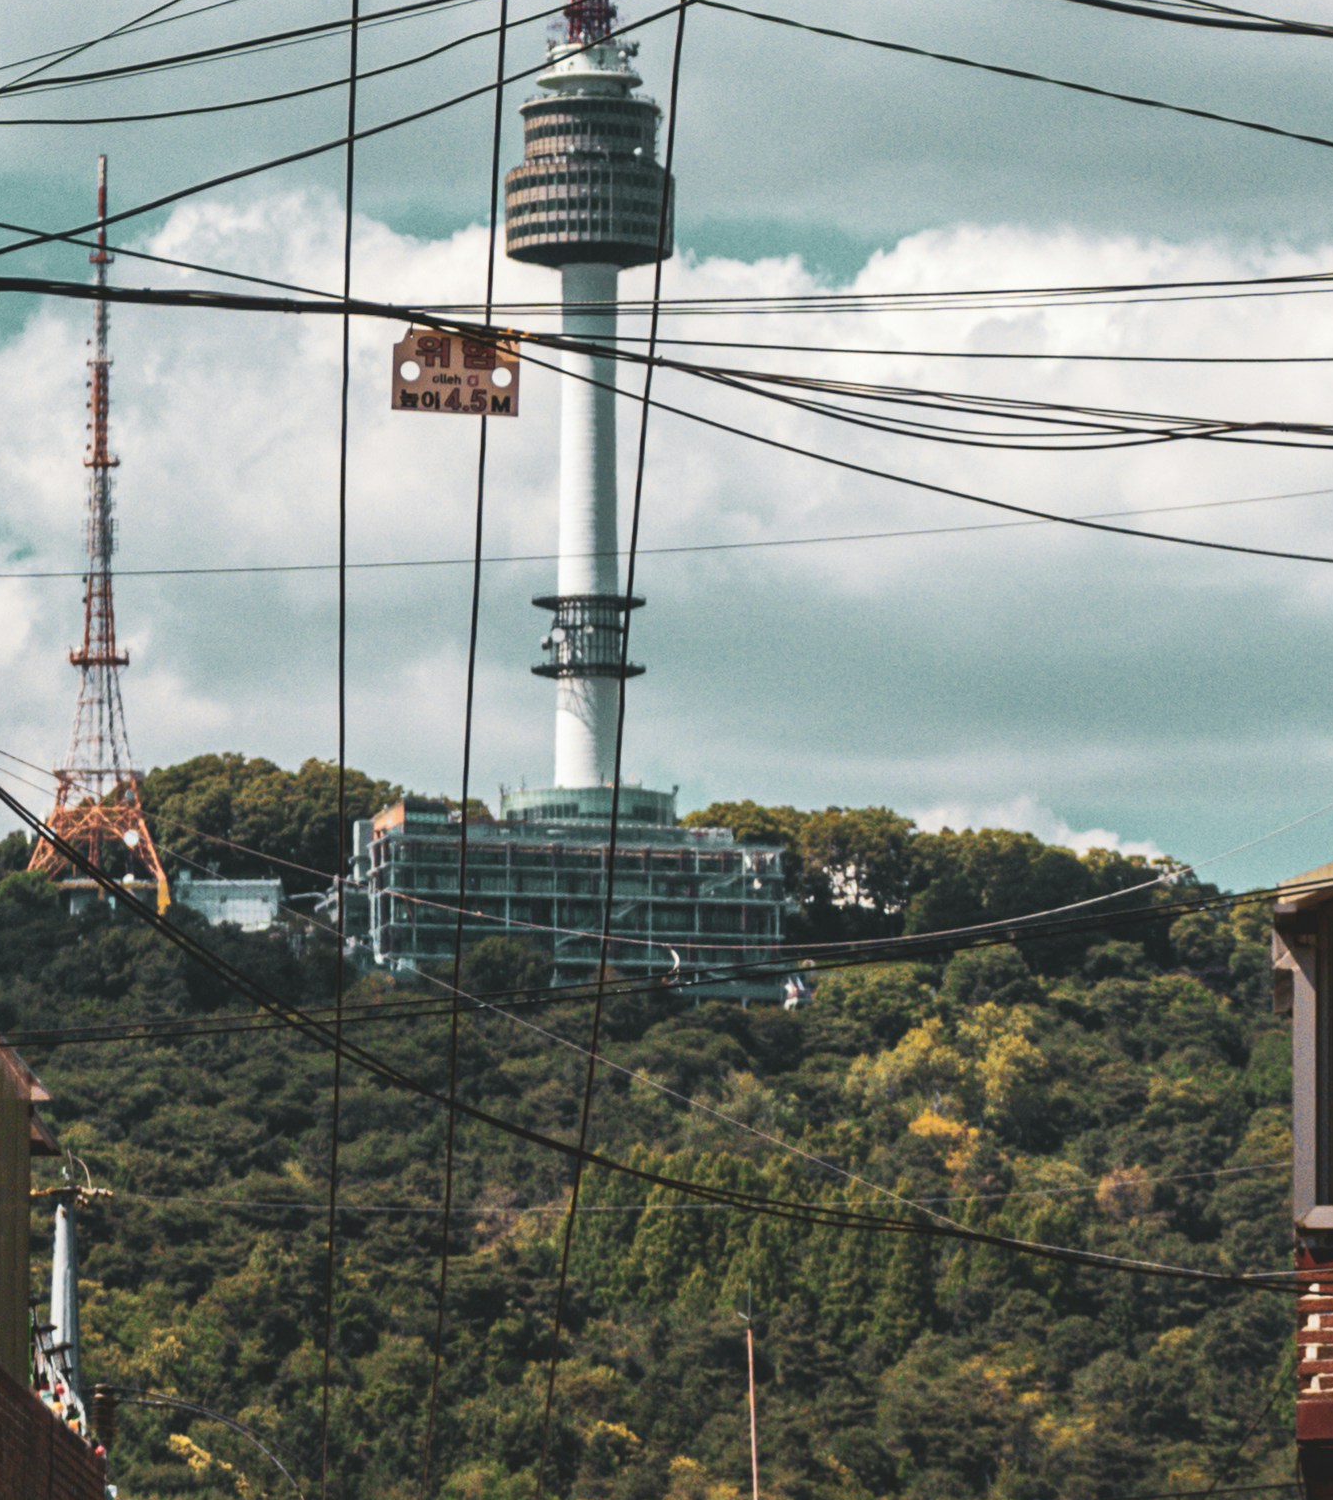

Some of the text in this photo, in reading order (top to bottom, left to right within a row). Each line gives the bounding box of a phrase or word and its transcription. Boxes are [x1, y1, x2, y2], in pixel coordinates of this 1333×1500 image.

[415, 336, 497, 370] 위험
[432, 374, 461, 385] olleh
[400, 388, 511, 412] 높이 4.5 M
